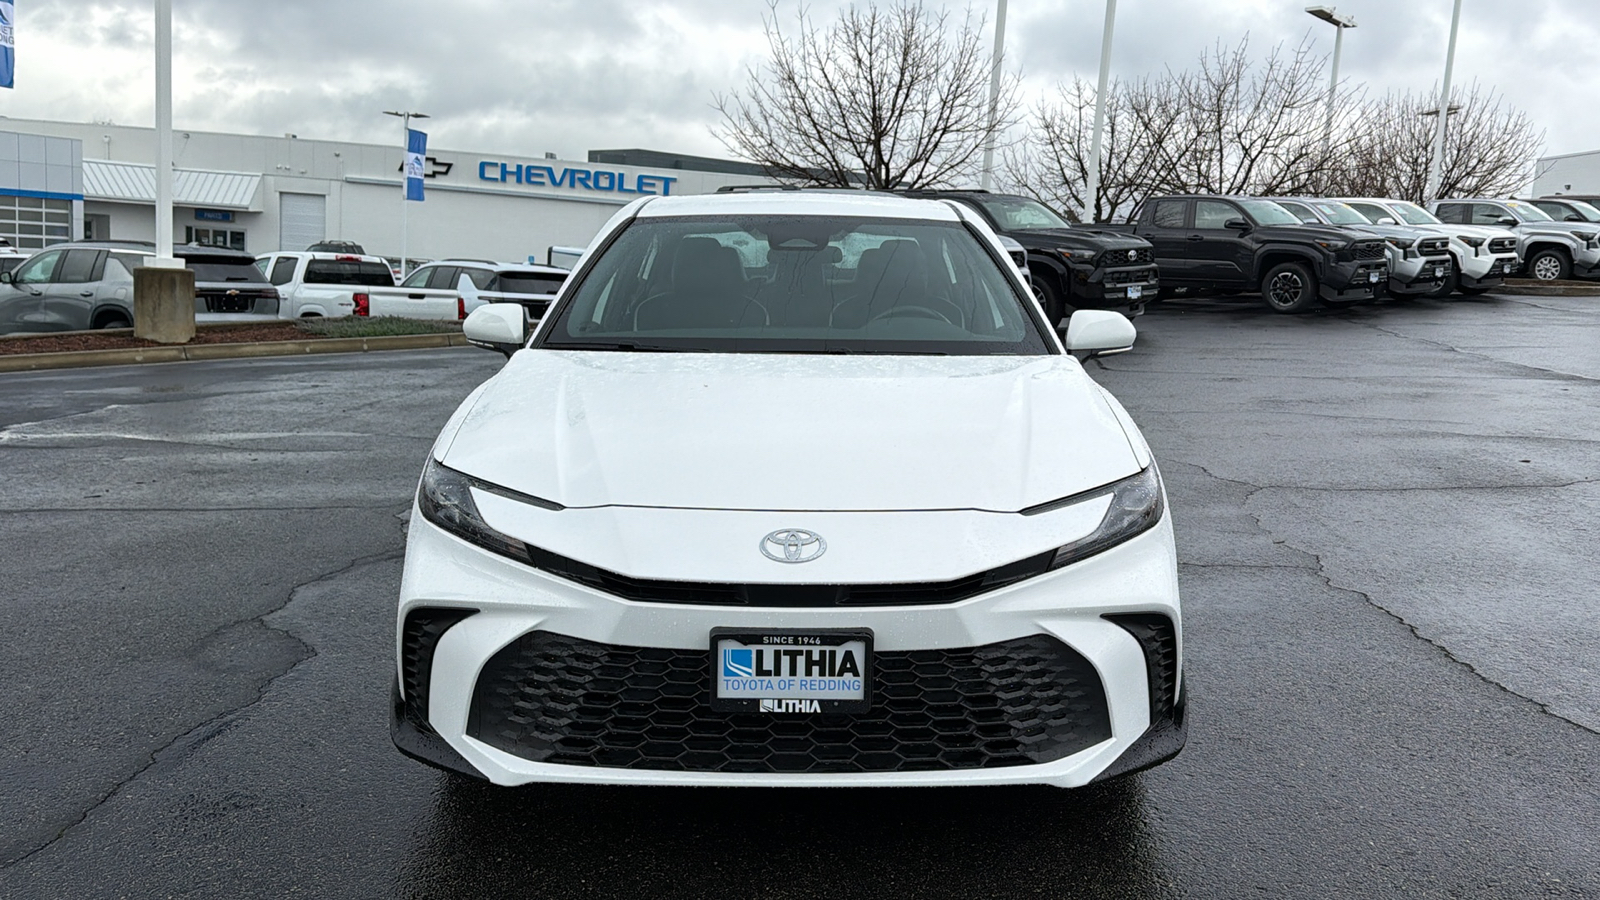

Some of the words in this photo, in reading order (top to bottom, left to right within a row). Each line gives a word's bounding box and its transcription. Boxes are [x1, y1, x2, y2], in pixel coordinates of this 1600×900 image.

[478, 161, 677, 196] CHEVROLET
[763, 636, 794, 644] SINCE
[798, 637, 821, 645] 1946
[755, 649, 860, 677] LITHIA
[723, 679, 774, 691] TOYOTA
[778, 679, 795, 691] OF
[800, 679, 861, 691] REDDING
[773, 699, 821, 713] LITHIA
